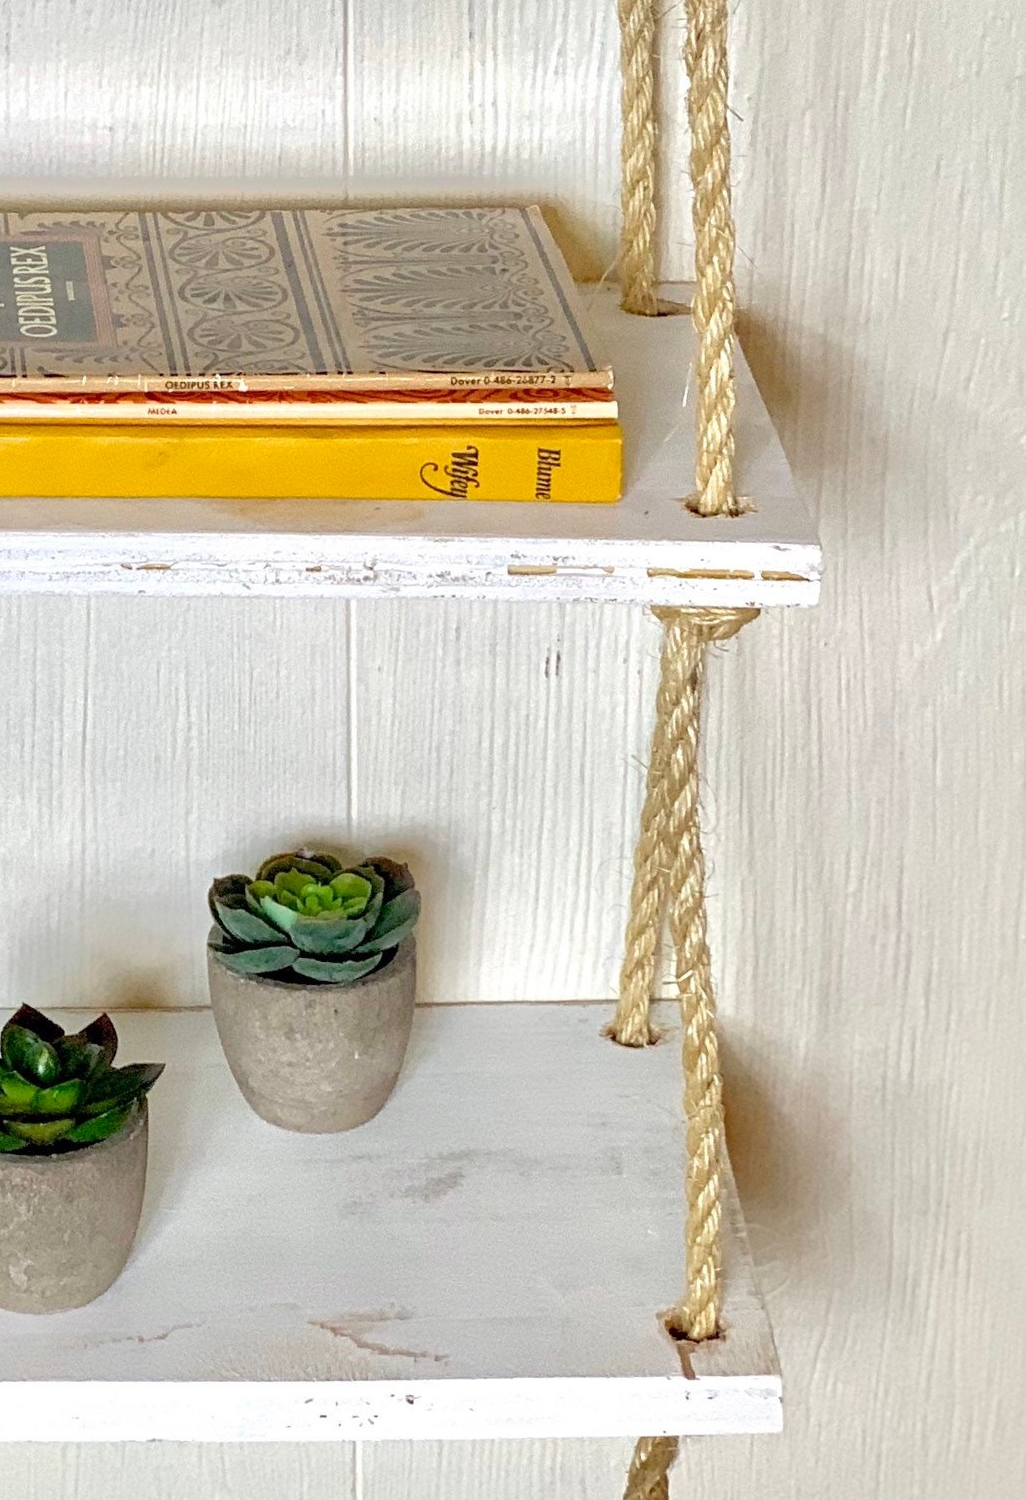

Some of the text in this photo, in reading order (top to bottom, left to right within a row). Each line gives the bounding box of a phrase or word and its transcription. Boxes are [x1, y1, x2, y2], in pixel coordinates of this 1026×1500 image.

[10, 245, 58, 338] OEDIPUS REX
[165, 381, 233, 390] OEDIPUS REX
[450, 376, 481, 386] Dover
[420, 445, 480, 499] Wifey
[535, 447, 562, 500] Blume
